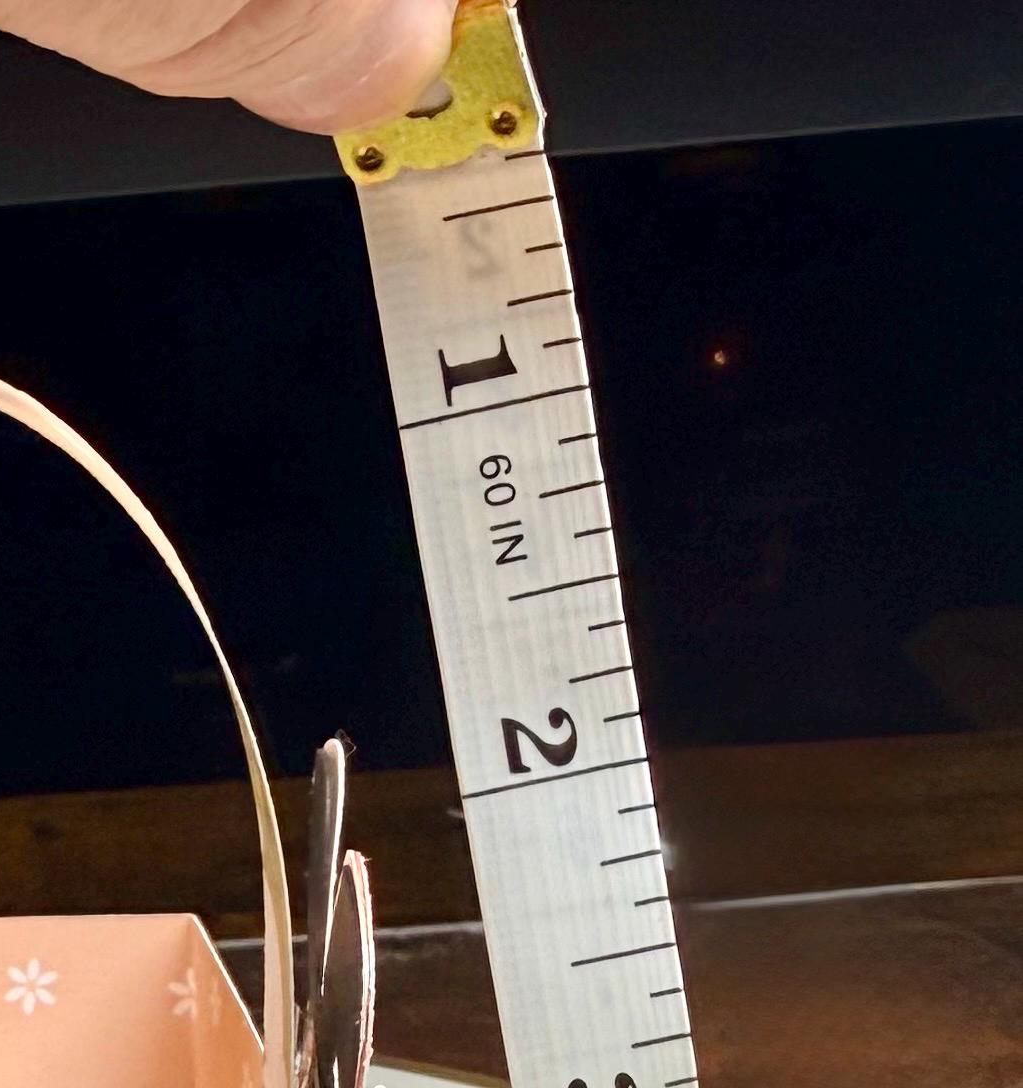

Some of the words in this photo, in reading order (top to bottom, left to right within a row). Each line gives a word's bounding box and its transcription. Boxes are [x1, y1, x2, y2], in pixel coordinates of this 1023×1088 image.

[437, 334, 518, 407] 1
[479, 454, 517, 507] 60
[489, 520, 528, 566] IN
[500, 707, 578, 774] 2
